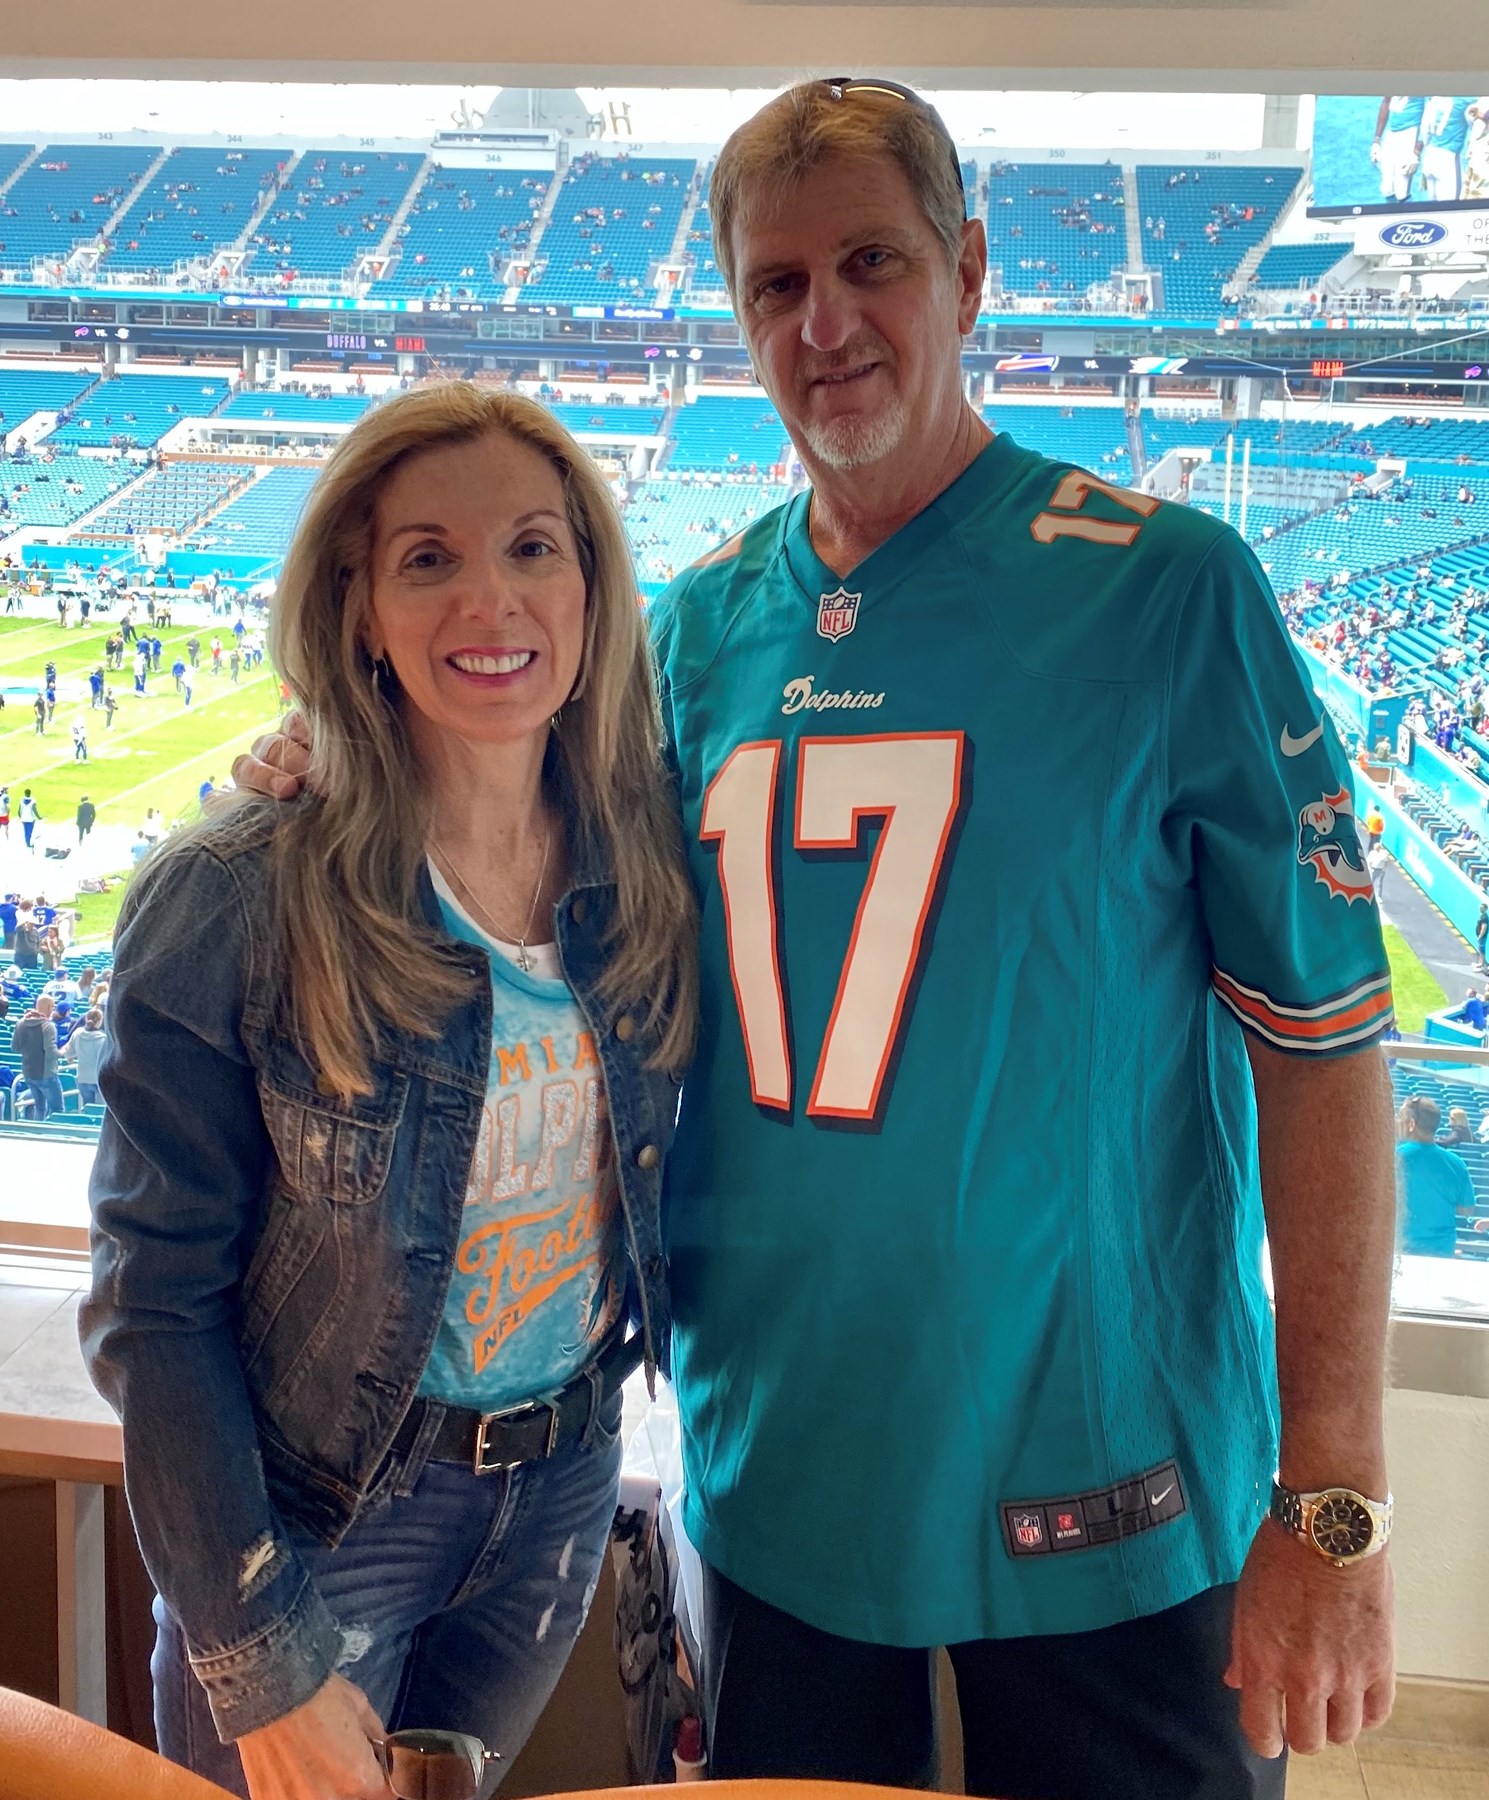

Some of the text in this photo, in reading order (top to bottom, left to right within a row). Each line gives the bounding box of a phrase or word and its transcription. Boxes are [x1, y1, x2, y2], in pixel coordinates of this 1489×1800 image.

[97, 131, 113, 141] 343
[226, 134, 243, 143] 344
[358, 138, 375, 147] 345
[627, 143, 644, 153] 347
[485, 153, 503, 163] 346
[1391, 223, 1435, 245] Ford
[326, 334, 367, 350] BUFFALO
[395, 335, 426, 351] MIAMI
[1311, 360, 1344, 377] MIAMI
[1030, 468, 1161, 547] 17
[822, 610, 850, 633] NFL
[781, 674, 886, 713] Dolphins
[1312, 809, 1327, 824] M
[699, 730, 967, 1124] 17
[496, 1031, 599, 1086] MIA
[483, 1308, 521, 1356] NFL
